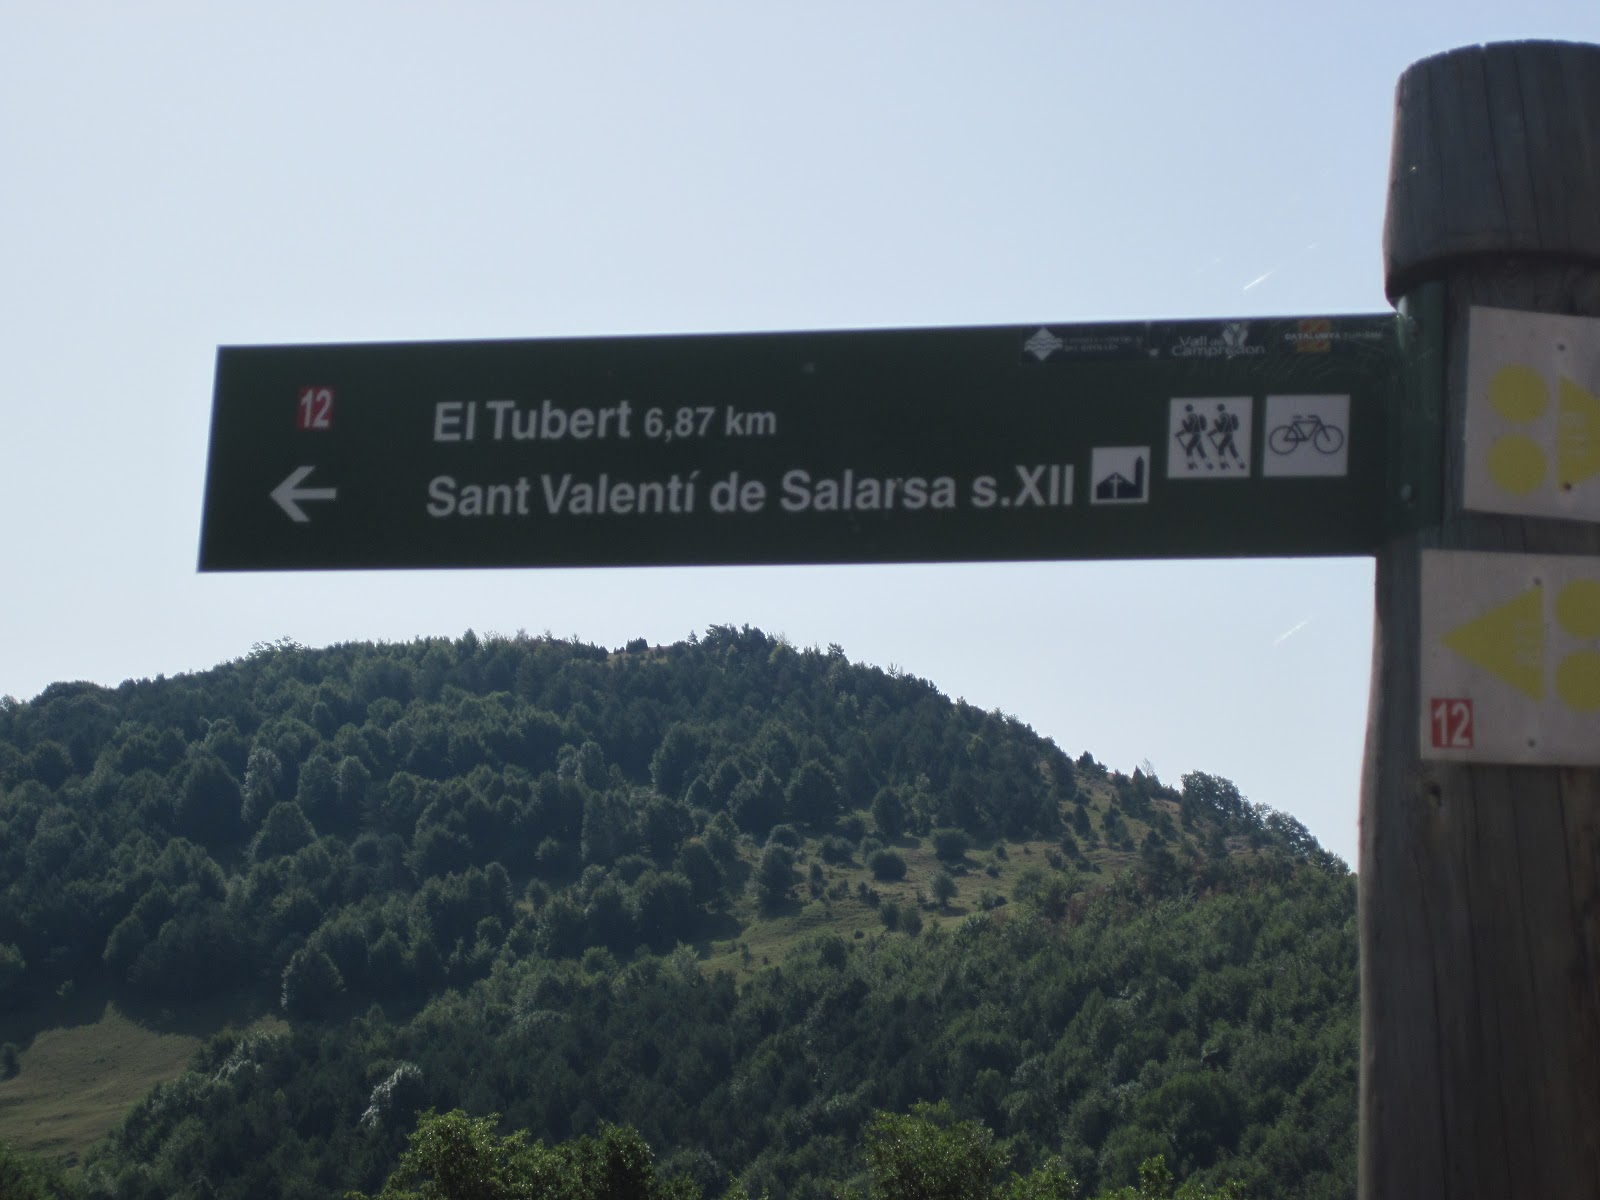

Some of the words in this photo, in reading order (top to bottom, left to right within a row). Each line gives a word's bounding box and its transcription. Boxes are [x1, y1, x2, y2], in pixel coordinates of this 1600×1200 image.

[300, 388, 333, 428] 12
[433, 401, 476, 441] El
[486, 399, 633, 440] Tubert
[643, 405, 715, 442] 6,87
[724, 405, 777, 436] km
[426, 475, 531, 517] Sant
[540, 470, 699, 514] Valentí
[709, 471, 767, 512] de
[779, 468, 956, 512] Salarsa
[971, 463, 1075, 507] s.XII
[1435, 702, 1470, 746] 12
